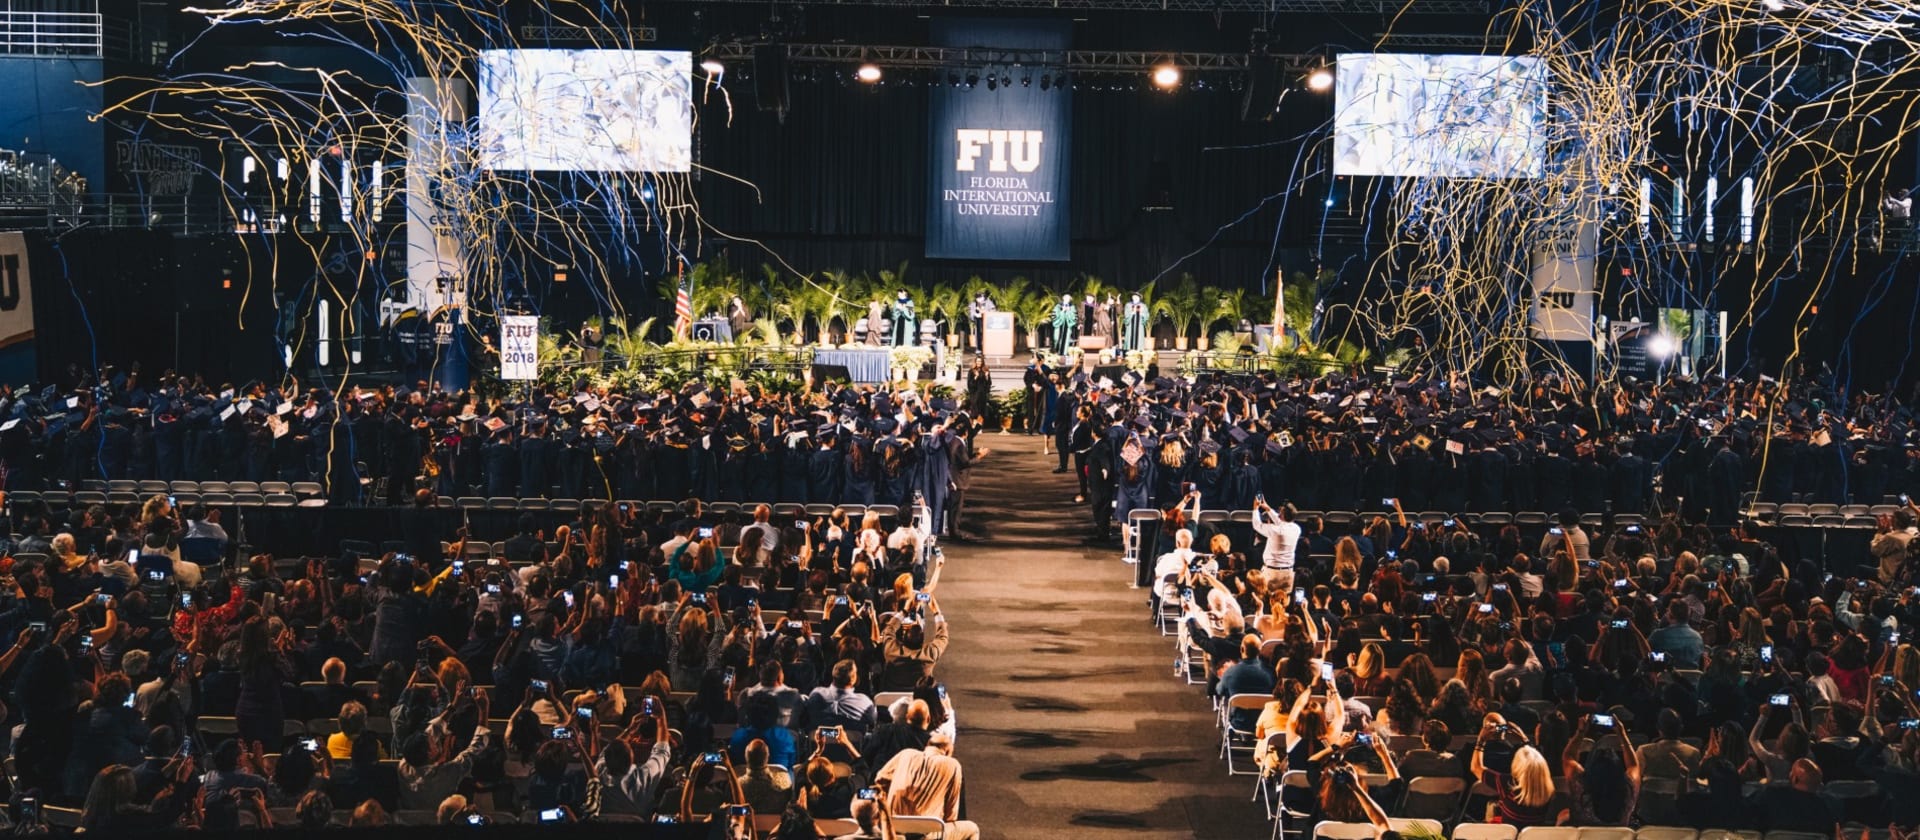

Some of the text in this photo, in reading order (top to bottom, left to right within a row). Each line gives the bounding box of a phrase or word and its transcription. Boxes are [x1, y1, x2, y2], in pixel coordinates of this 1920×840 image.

[956, 129, 1043, 172] FIU
[970, 177, 1028, 189] FLORIDA
[944, 190, 1054, 203] INTERNATIONAL
[957, 204, 1040, 216] UNIVERSITY
[505, 324, 534, 337] FIU
[505, 352, 535, 364] 2018
